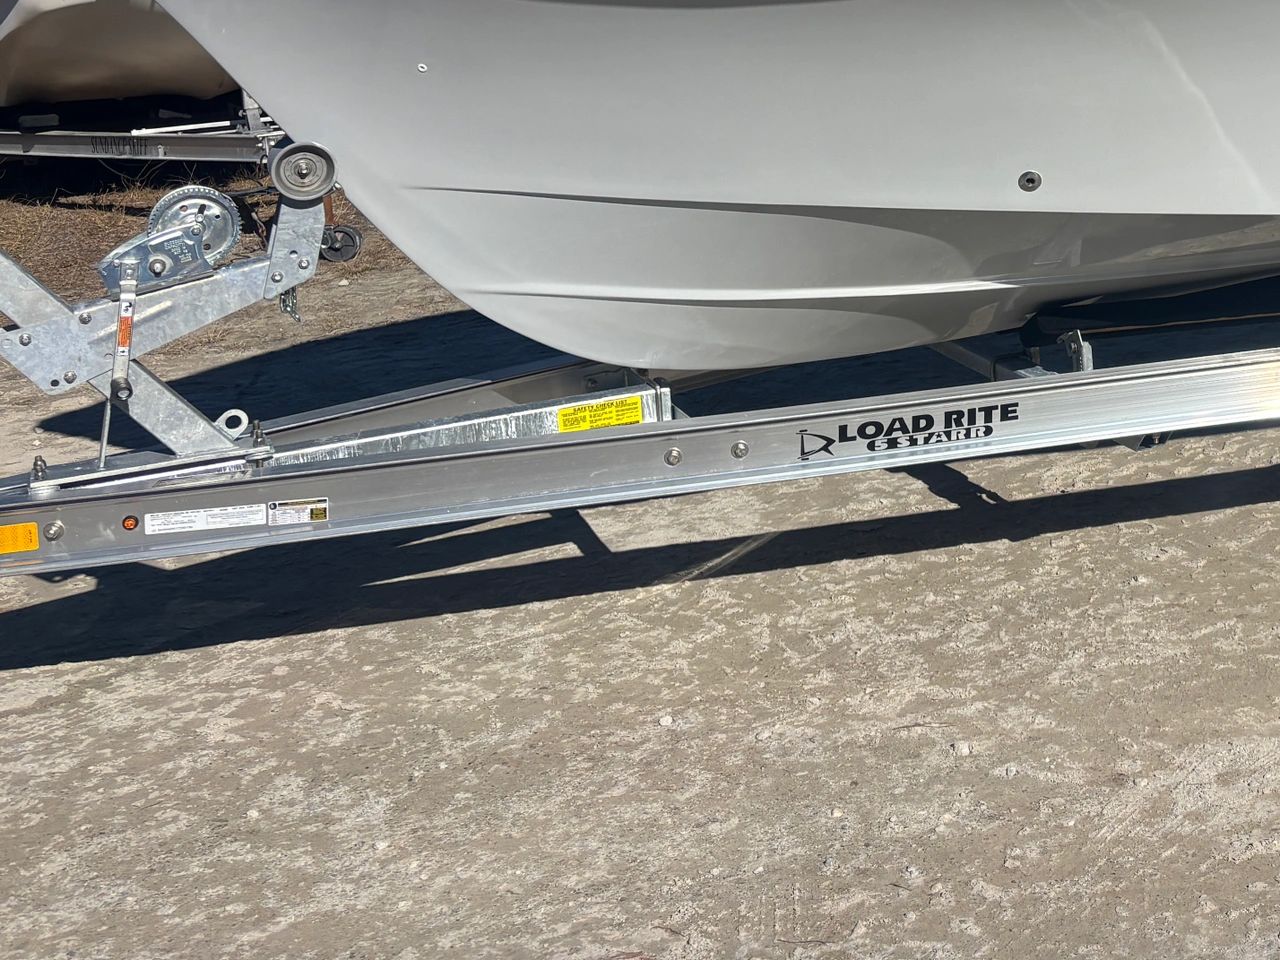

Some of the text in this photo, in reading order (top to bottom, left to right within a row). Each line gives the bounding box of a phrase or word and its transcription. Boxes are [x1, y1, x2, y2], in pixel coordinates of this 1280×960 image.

[838, 402, 1019, 443] LOAD RITE
[874, 439, 888, 451] 5
